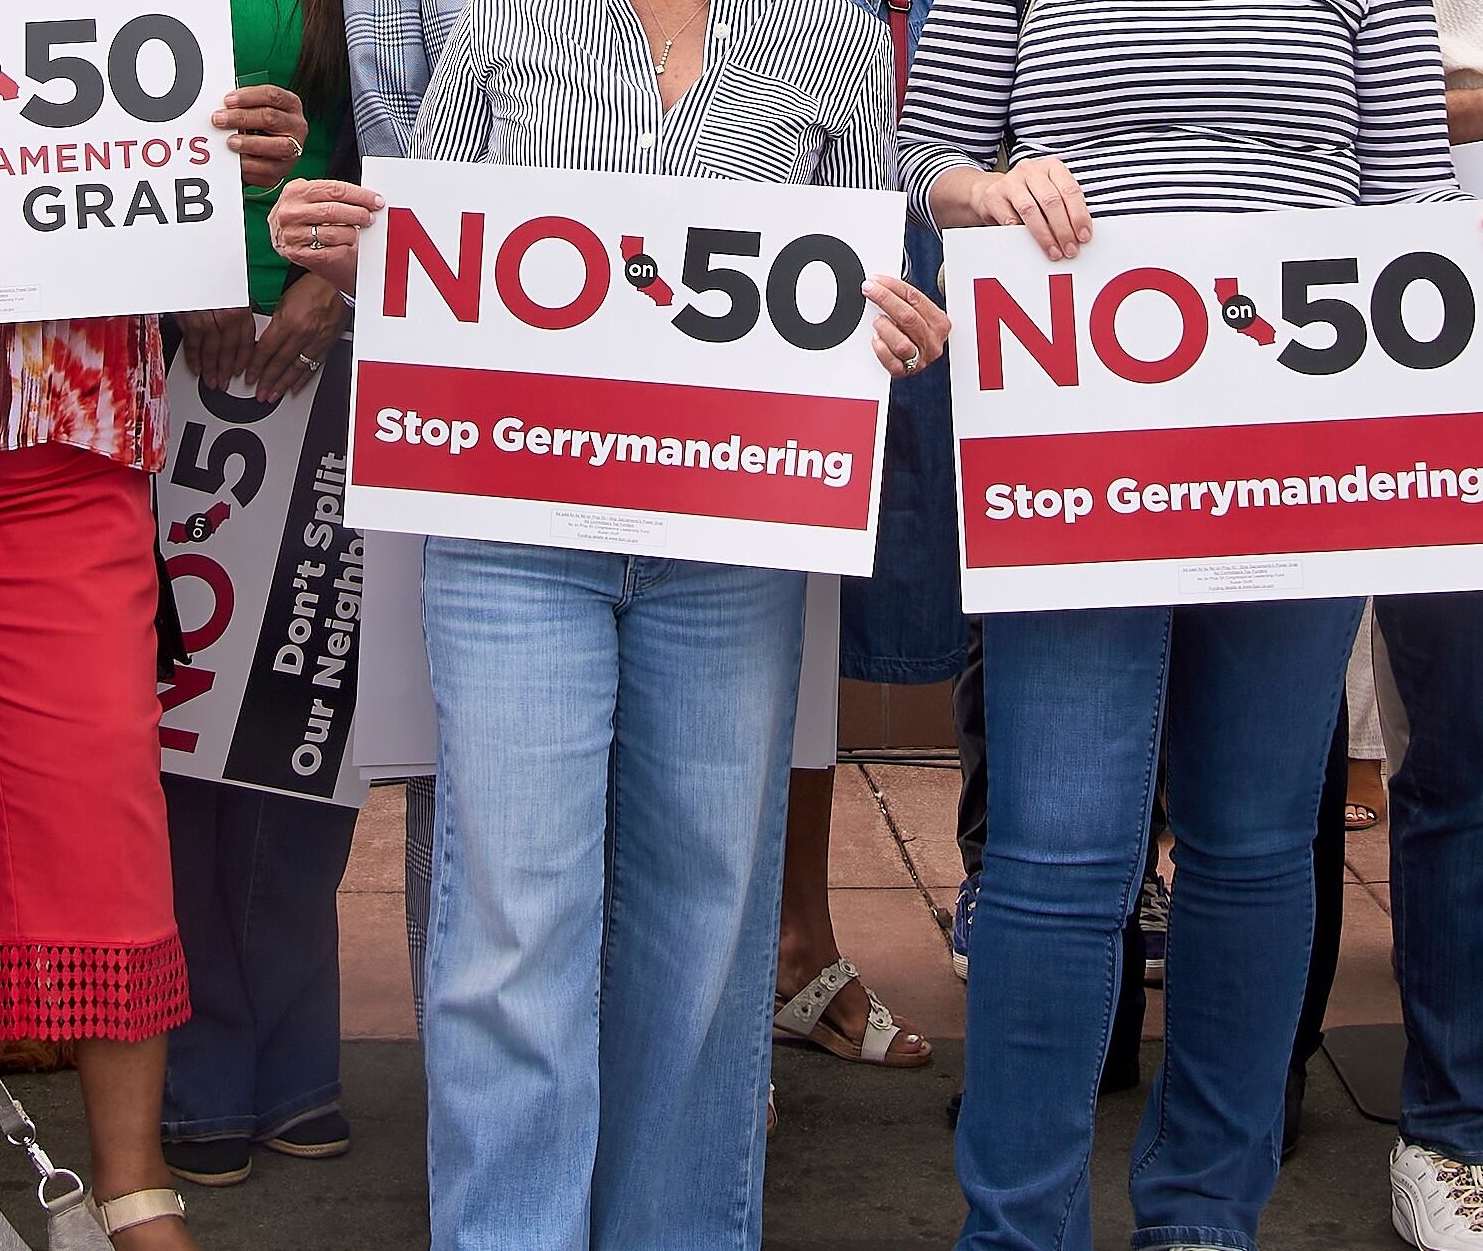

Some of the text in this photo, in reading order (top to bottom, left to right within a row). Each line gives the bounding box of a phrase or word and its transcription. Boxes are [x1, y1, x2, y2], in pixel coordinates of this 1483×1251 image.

[19, 13, 204, 128] 50
[23, 177, 214, 234] GRAB
[382, 207, 867, 350] NO on 50
[973, 251, 1476, 390] NO on 50
[374, 406, 853, 488] Stop Gerrymandering
[192, 517, 206, 538] on
[984, 484, 1094, 524] Stop
[273, 450, 347, 676] Don't Split
[291, 699, 335, 777] Our
